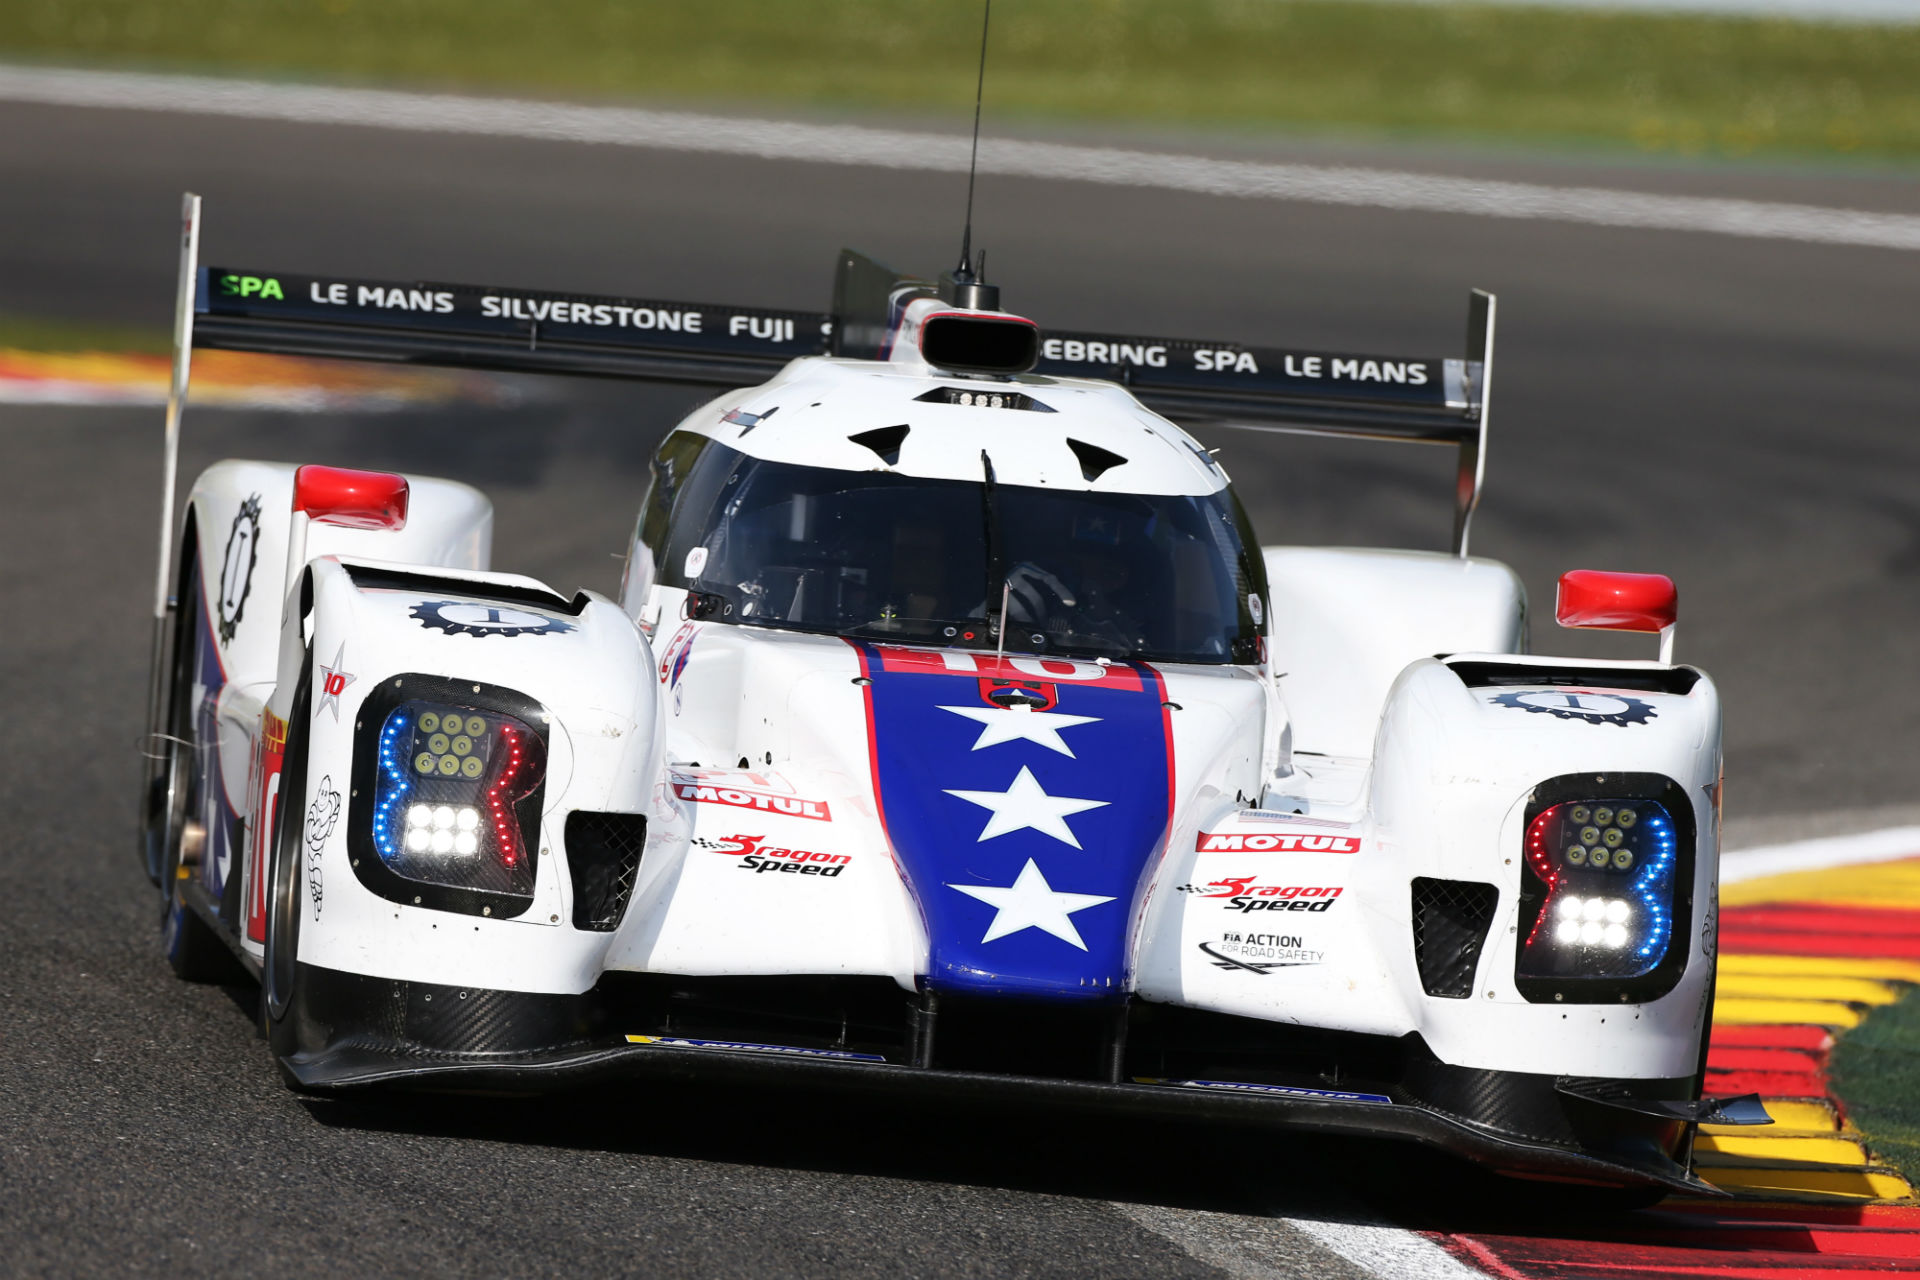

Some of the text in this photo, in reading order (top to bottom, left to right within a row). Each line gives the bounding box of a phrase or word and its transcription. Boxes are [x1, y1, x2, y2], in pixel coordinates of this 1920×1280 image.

[221, 275, 284, 300] SPA
[310, 282, 348, 305] LE
[357, 286, 454, 313] MANS
[481, 296, 702, 333] SILVERSTONE
[729, 316, 794, 342] FUJI
[1039, 338, 1428, 384] EBRING SPA LE MANS
[323, 672, 346, 696] 10
[680, 786, 824, 818] MOTUL
[1202, 835, 1354, 851] MOTUL
[737, 855, 845, 877] Speed
[1223, 896, 1335, 913] Speed
[1245, 933, 1302, 948] ACTION
[1221, 944, 1324, 961] FOR ROAD SAFETY
